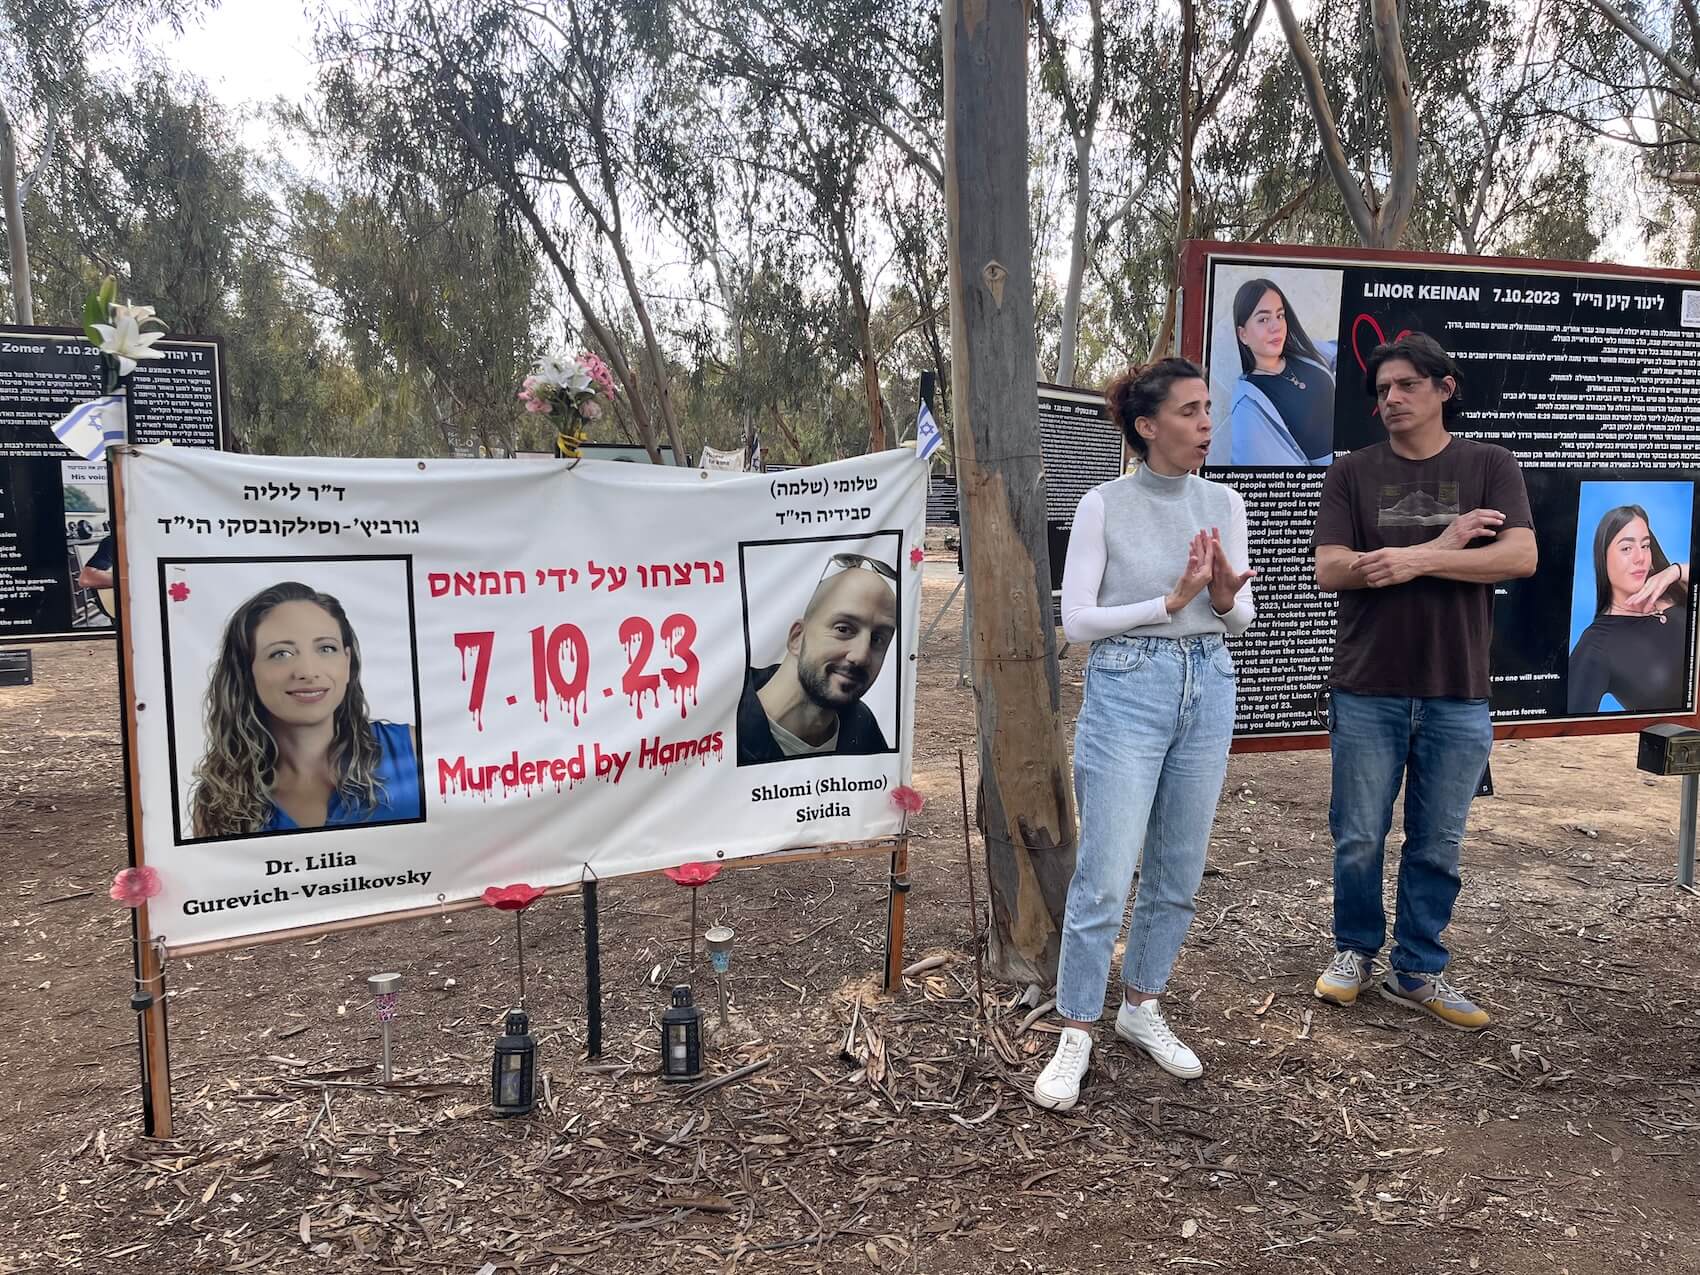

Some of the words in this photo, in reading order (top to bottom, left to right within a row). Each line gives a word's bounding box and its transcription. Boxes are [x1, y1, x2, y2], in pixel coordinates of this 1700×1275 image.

[1364, 283, 1413, 298] LINOR
[1419, 286, 1479, 301] KEINAN
[1494, 289, 1560, 304] 7.10.2023
[1606, 295, 1630, 311] קינן
[1634, 295, 1664, 310] לינור
[2, 343, 46, 354] Zomer
[191, 351, 203, 362] דן
[71, 473, 86, 481] His
[1226, 471, 1254, 480] always
[1256, 471, 1284, 479] wanted
[1296, 471, 1306, 479] do
[1307, 472, 1326, 480] good
[771, 478, 828, 499] (שלמה)
[834, 476, 877, 492] שלומי
[1240, 481, 1266, 490] people
[244, 482, 300, 500] ליליה
[1248, 491, 1267, 499] open
[1278, 501, 1297, 509] good
[817, 508, 870, 522] סבידיה
[1261, 519, 1288, 527] always
[1247, 528, 1266, 537] good
[1267, 528, 1282, 537] just
[1284, 528, 1297, 536] the
[1298, 529, 1314, 537] way
[1277, 547, 1296, 555] good
[1272, 556, 1305, 564] traveling
[588, 560, 627, 592] על
[637, 560, 725, 588] נרצחו
[428, 571, 526, 597] חמאס
[536, 569, 579, 592] ידי
[1278, 583, 1296, 591] their
[1294, 592, 1317, 600] aside,
[1318, 591, 1338, 599] filled
[1272, 620, 1298, 628] friends
[1299, 620, 1313, 629] got
[1287, 629, 1310, 637] police
[1224, 639, 1243, 647] back
[1269, 638, 1295, 647] party's
[1297, 637, 1327, 645] location
[1241, 666, 1270, 674] Kibbutz
[1298, 665, 1316, 673] They
[1257, 675, 1285, 683] several
[1287, 674, 1322, 683] grenades
[1249, 721, 1264, 730] you
[1265, 720, 1291, 728] dearly,
[1292, 719, 1309, 728] your
[1497, 708, 1520, 717] hearts
[1521, 707, 1547, 715] forever.
[1252, 712, 1276, 720] loving
[437, 744, 586, 795] Murdered
[594, 743, 631, 783] by
[639, 732, 724, 768] Hamas
[752, 781, 811, 801] Shlomi
[816, 775, 887, 796] (Shlomo)
[797, 803, 850, 822] Sividia
[266, 860, 299, 875] Dr.
[306, 852, 356, 870] Lilia
[183, 869, 432, 917] Gurevich-Vasilkovsky
